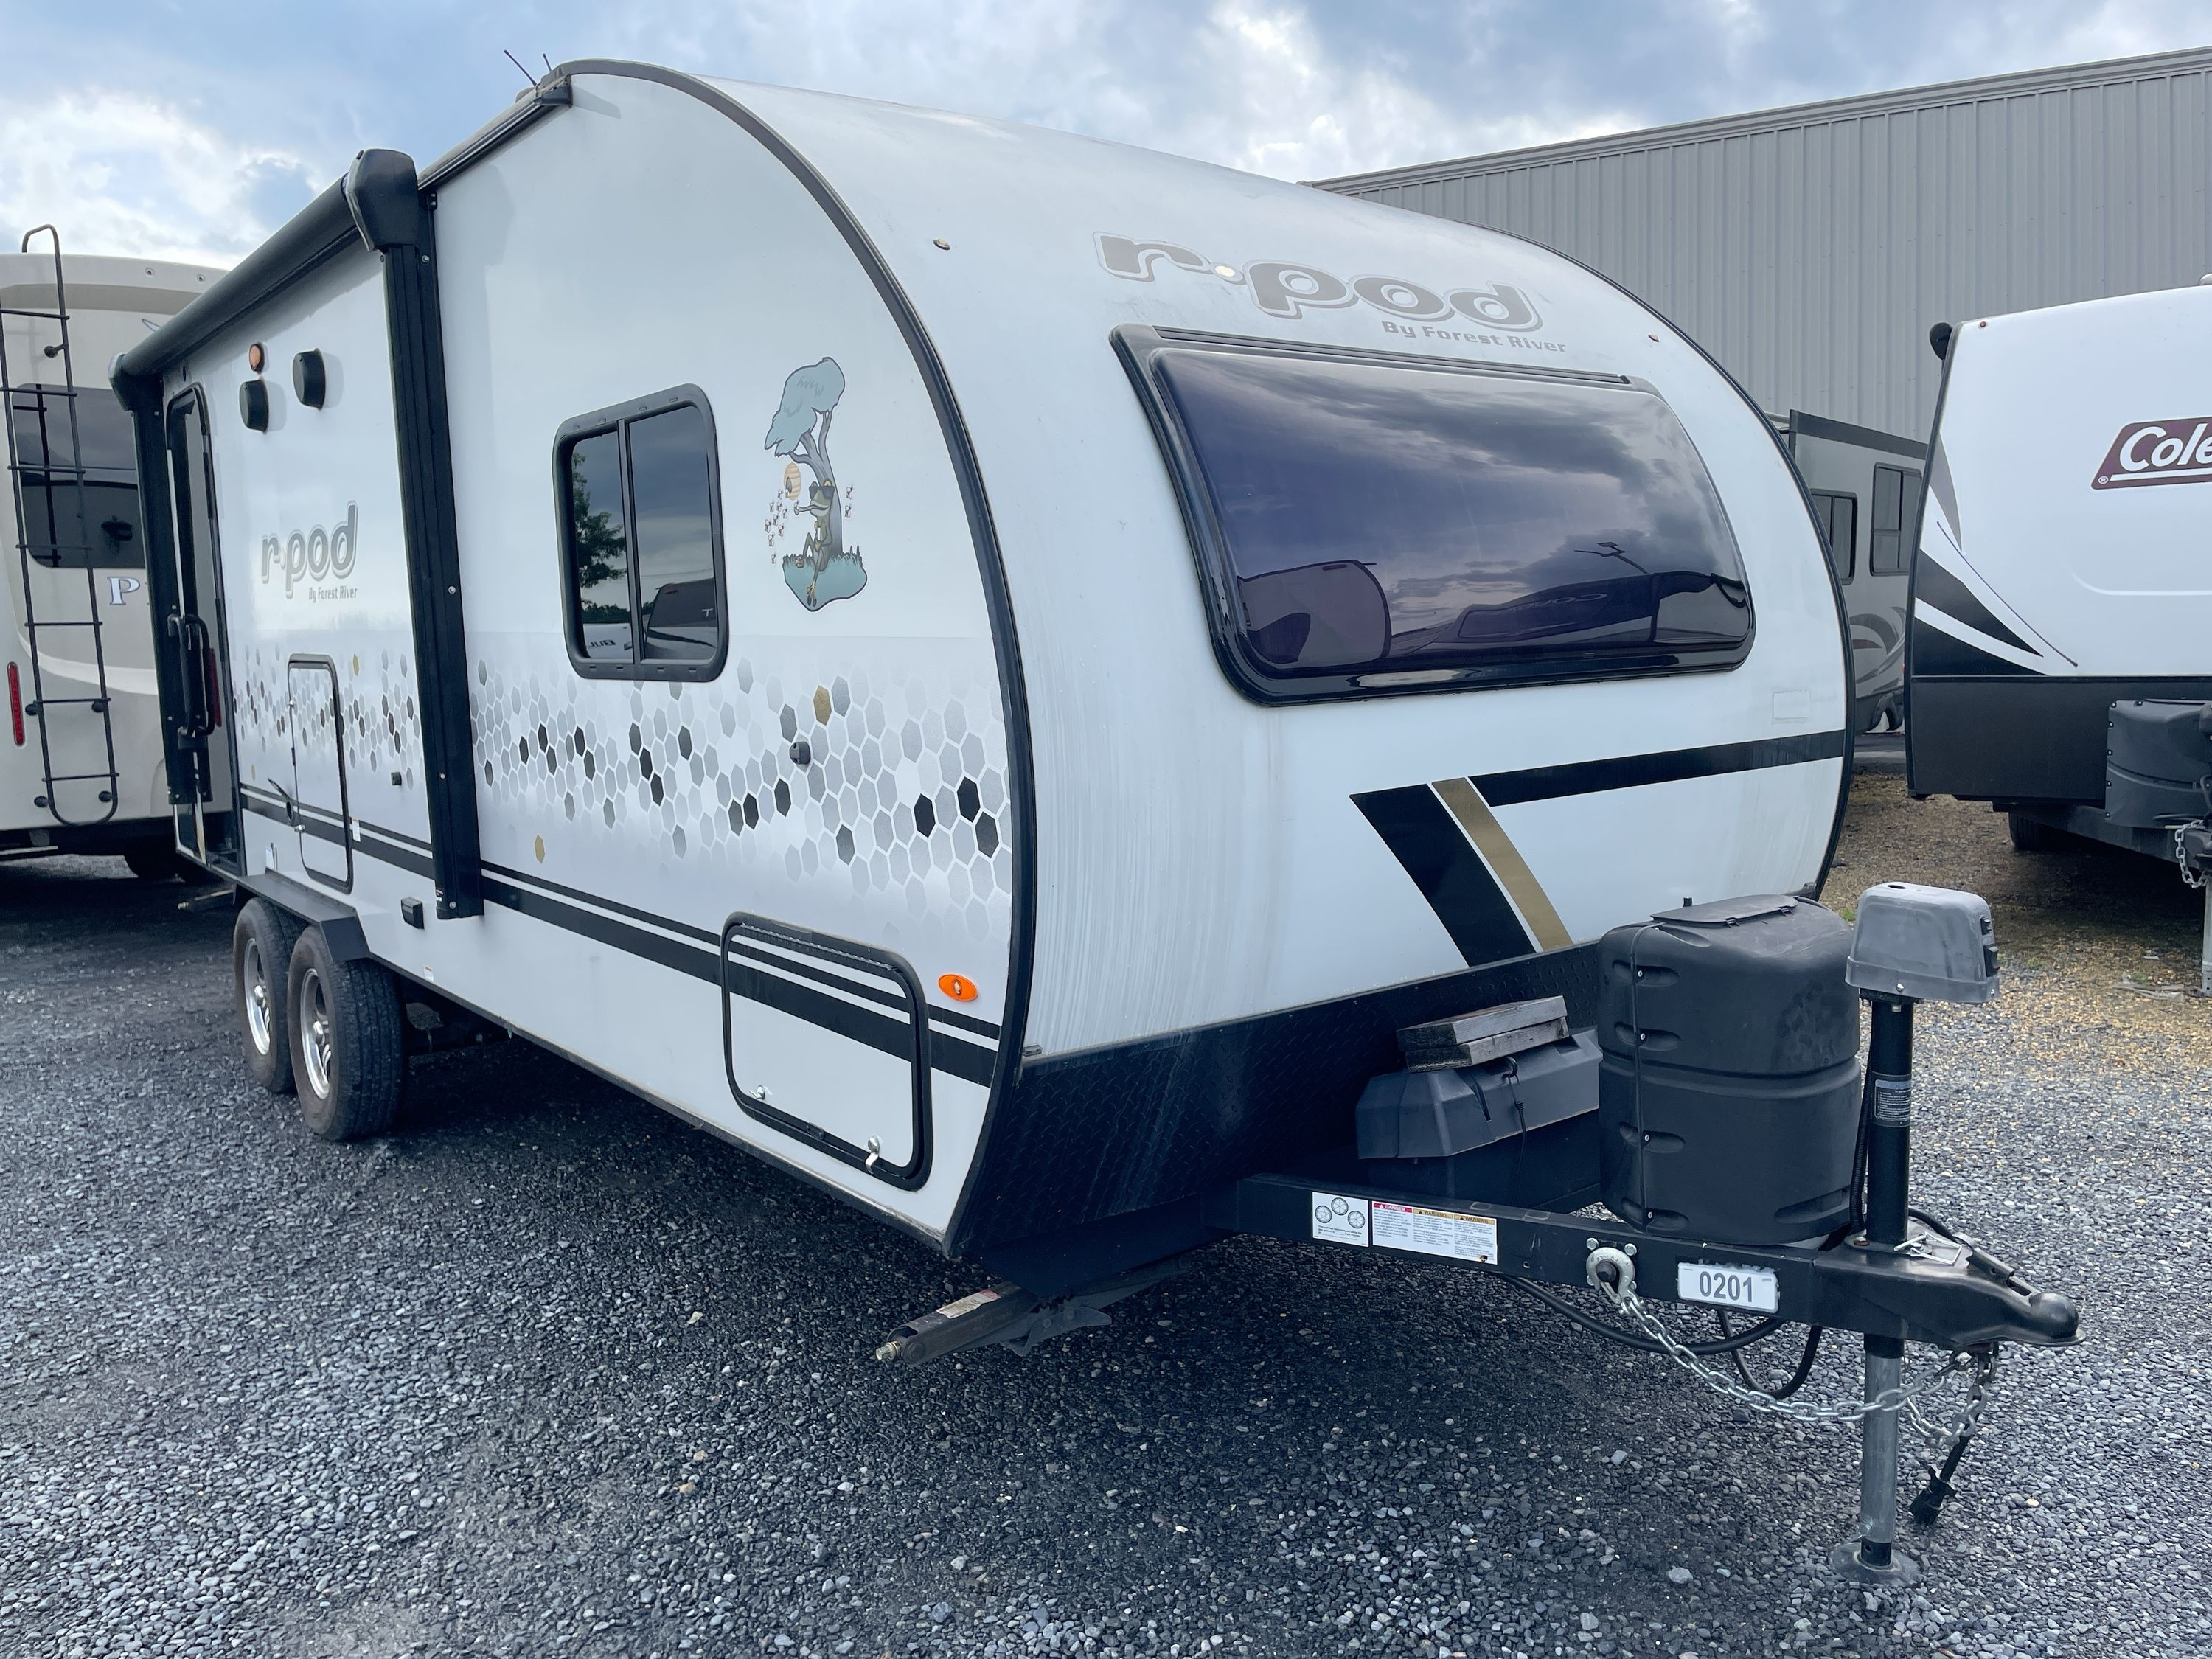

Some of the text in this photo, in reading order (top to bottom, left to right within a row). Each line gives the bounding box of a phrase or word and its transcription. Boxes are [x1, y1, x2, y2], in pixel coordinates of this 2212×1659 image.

[1382, 321, 1566, 352] By Forest River
[107, 576, 150, 605] P
[309, 585, 358, 603] By Forest River
[1465, 1216, 1489, 1224] WARNING
[1699, 1270, 1753, 1303] 0201
